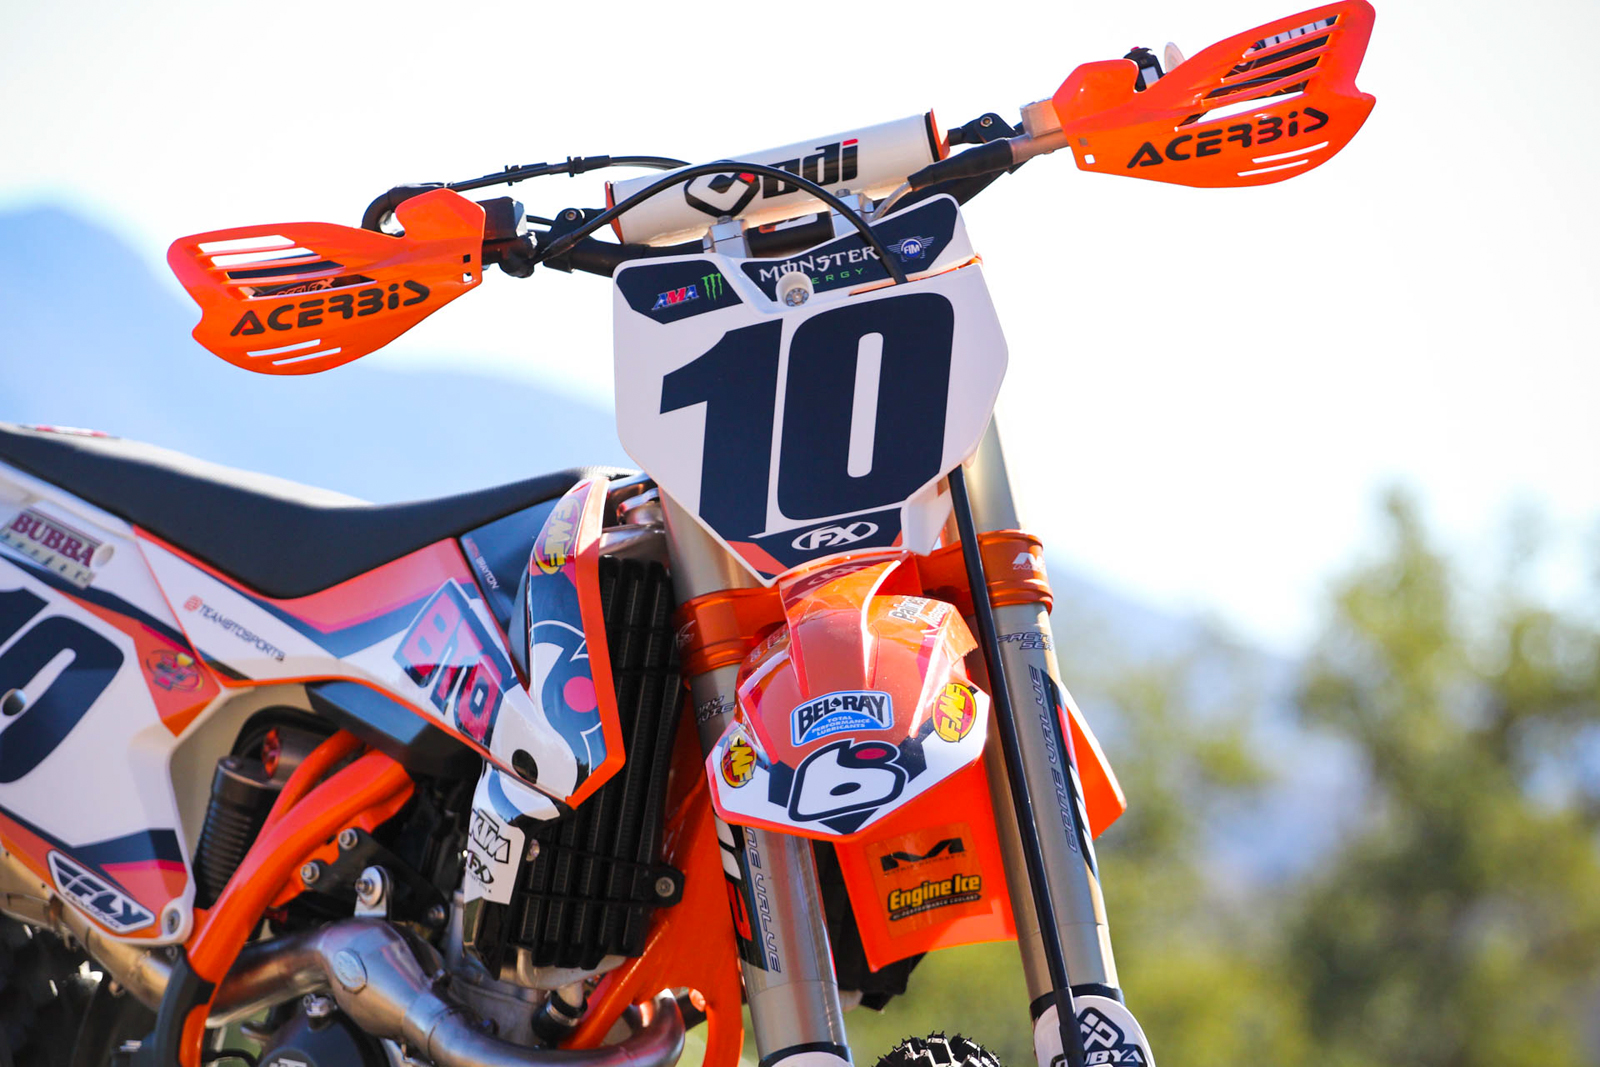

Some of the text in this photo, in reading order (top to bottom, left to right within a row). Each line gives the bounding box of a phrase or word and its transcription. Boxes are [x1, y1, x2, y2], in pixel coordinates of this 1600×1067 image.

[759, 246, 881, 282] MONSTER
[903, 243, 921, 255] FIM
[811, 267, 865, 285] ERGY
[651, 284, 700, 311] AMA
[660, 291, 955, 533] 10
[10, 513, 96, 568] BUBBA
[812, 718, 871, 733] PERFORMANCE
[827, 715, 853, 723] TOTAL
[938, 682, 966, 743] FMF
[816, 723, 866, 736] LUBRICANTS
[53, 856, 152, 926] FLY
[888, 873, 982, 913] Engine Ice
